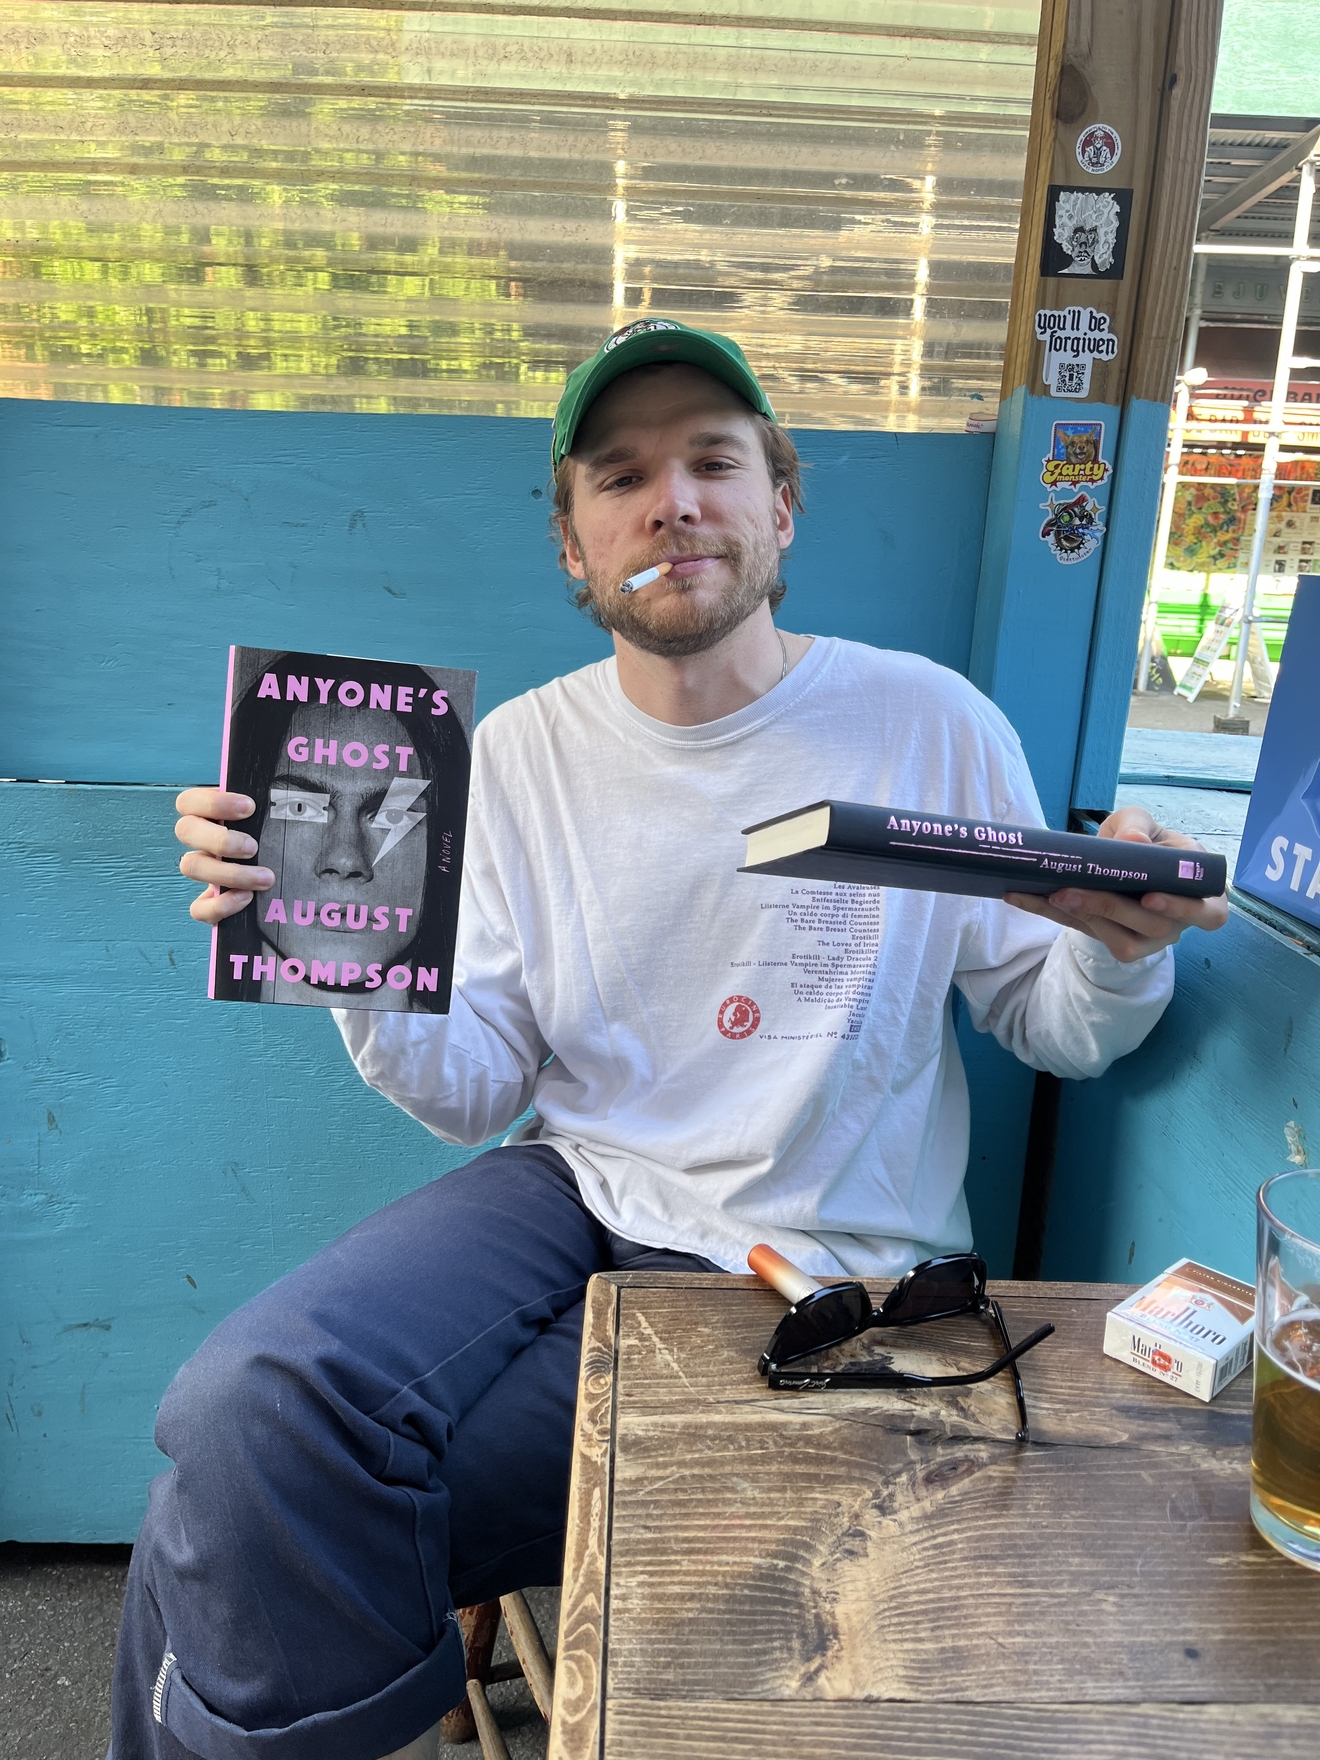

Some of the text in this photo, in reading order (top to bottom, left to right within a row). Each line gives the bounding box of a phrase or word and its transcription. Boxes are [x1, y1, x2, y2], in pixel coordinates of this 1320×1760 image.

[1037, 309, 1107, 335] you'll be
[1048, 330, 1116, 358] forgiven
[257, 673, 449, 716] ANYONE'S
[287, 736, 414, 772] GHOST
[887, 815, 1024, 846] Anyone's Ghost
[438, 830, 453, 873] A NOVEL
[1040, 858, 1149, 881] August Thompson
[264, 898, 413, 933] AUGUST
[851, 898, 880, 906] Begierde
[229, 954, 438, 992] THOMPSON
[790, 960, 818, 968] Vampire
[720, 1027, 756, 1039] PARIS
[1130, 1296, 1227, 1345] Marlboro
[1131, 1334, 1183, 1373] Marro
[1132, 1357, 1157, 1373] BLEND
[1170, 1374, 1179, 1383] 27
